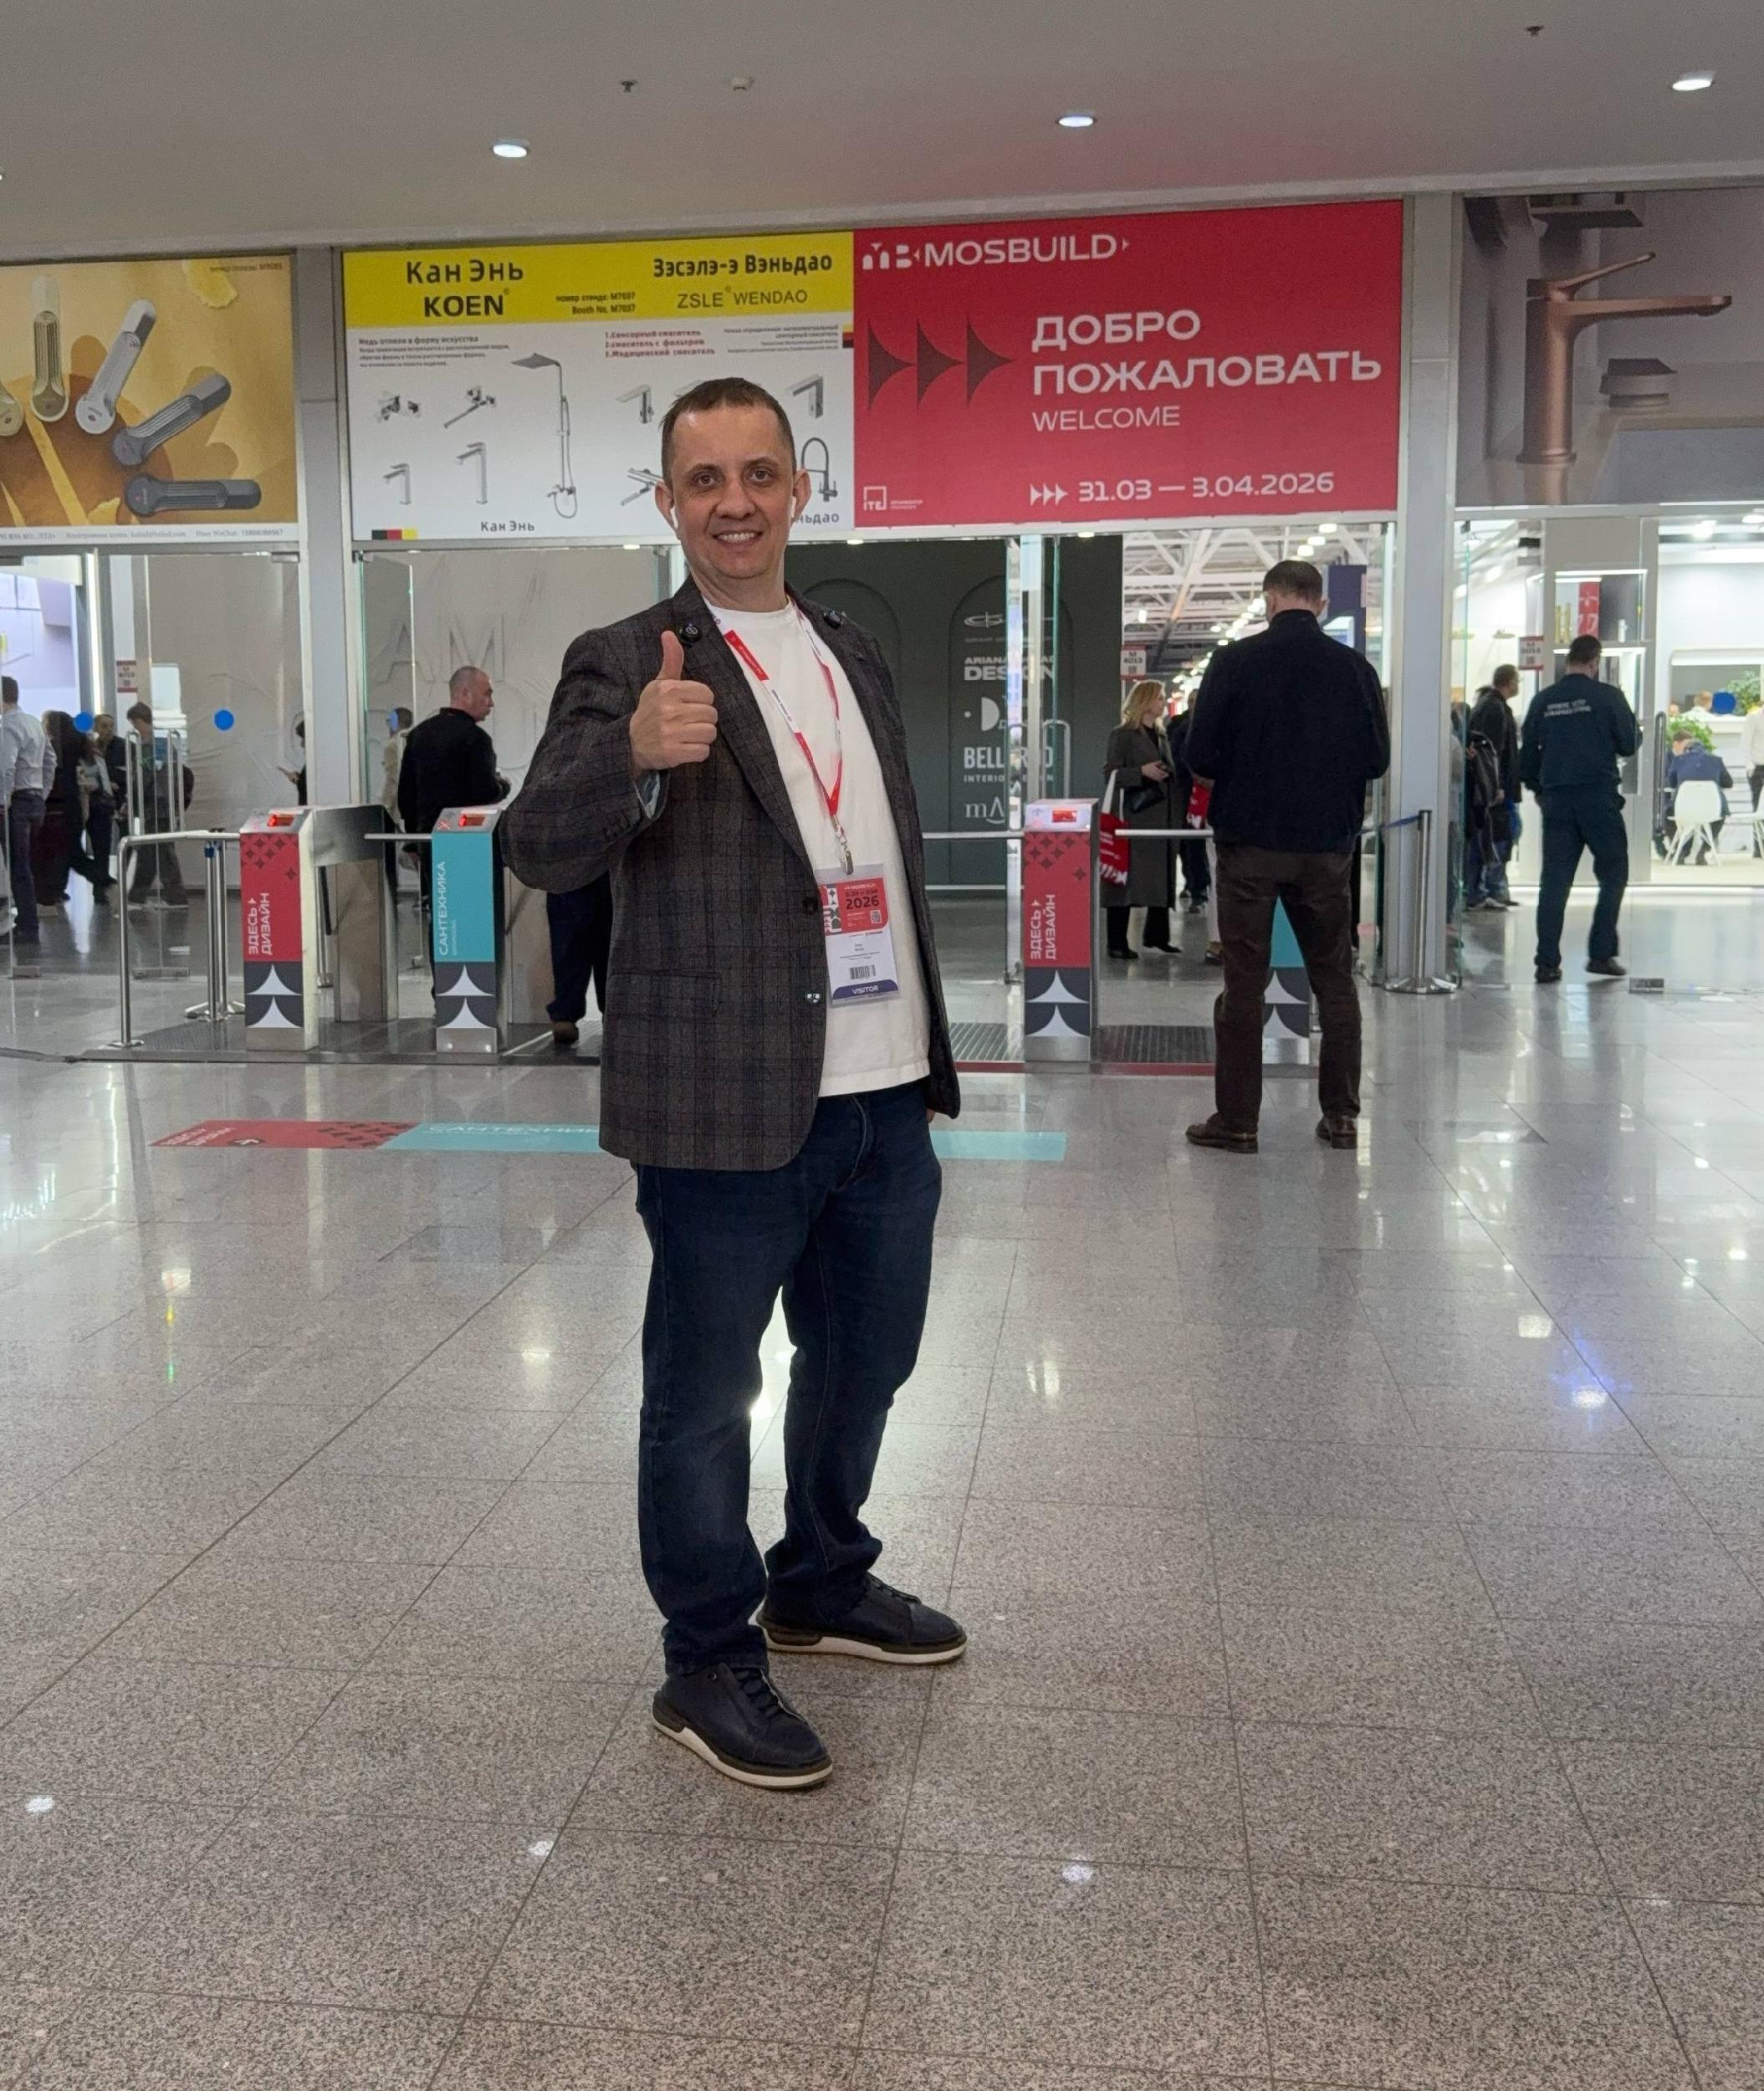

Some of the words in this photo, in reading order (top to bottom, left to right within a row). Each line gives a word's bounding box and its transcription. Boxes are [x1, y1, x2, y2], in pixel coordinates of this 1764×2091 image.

[924, 234, 1117, 267] MOSBUILD
[406, 261, 460, 284] Кан
[469, 258, 524, 283] Энь
[653, 256, 739, 278] Зэсэлэ-э
[744, 253, 832, 276] Вэньдао
[424, 294, 504, 317] KOEN
[677, 292, 723, 309] ZSLE
[733, 289, 808, 306] WENDAO
[1031, 309, 1201, 353] ДОБРО
[1033, 350, 1382, 396] ПОЖАЛОВАТЬ
[1031, 405, 1180, 432] WELCOME
[1078, 478, 1153, 502] 31.03
[1192, 472, 1334, 498] 3.04.2026
[481, 521, 506, 532] Кан
[509, 520, 535, 532] Энь
[797, 513, 840, 525] ньдао
[964, 774, 1005, 784] INTERIO
[439, 861, 447, 956] САНТЕХНИКА
[846, 895, 880, 910] 2026
[248, 906, 258, 955] ЗДЕСЬ
[259, 892, 273, 955] ДИЗАЙН
[1030, 910, 1042, 959] ЗДЕСЬ
[1043, 894, 1057, 960] ДИЗАЙН
[852, 984, 879, 995] VISITOR
